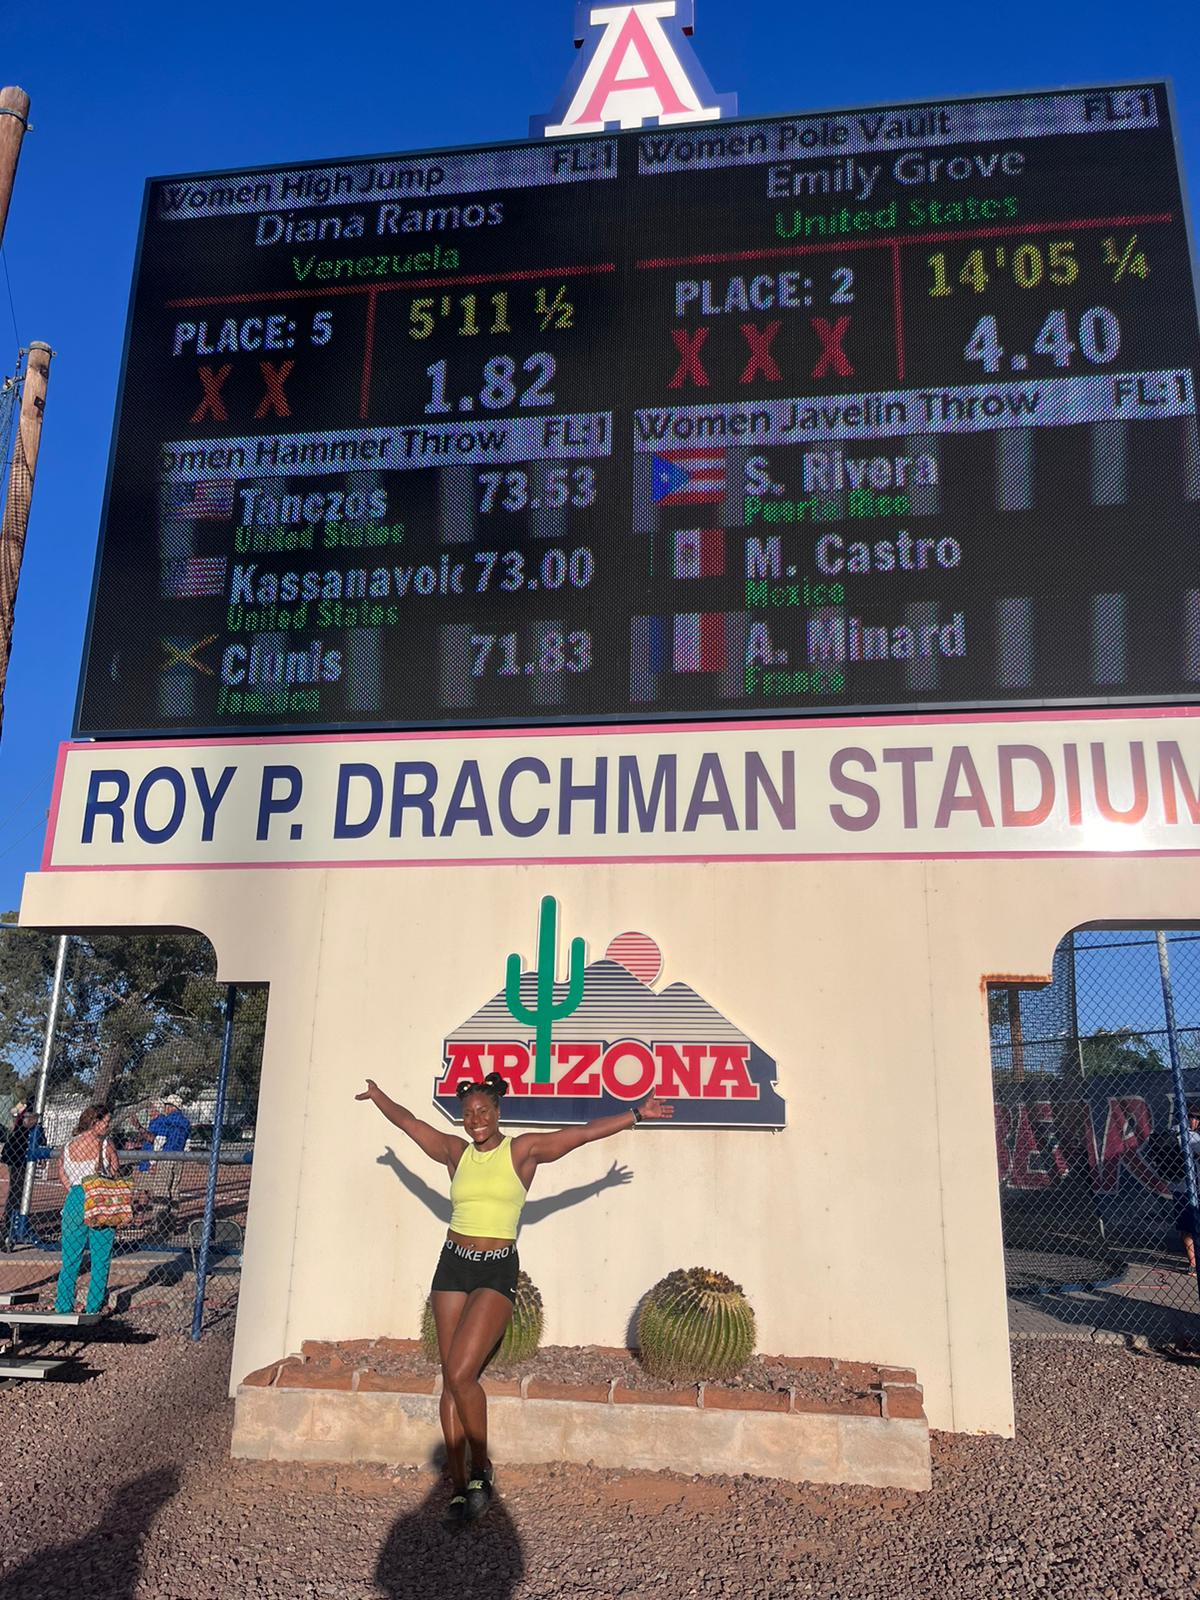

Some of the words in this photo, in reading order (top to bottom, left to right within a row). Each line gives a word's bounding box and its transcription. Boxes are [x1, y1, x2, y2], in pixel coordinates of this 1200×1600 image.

[640, 129, 767, 164] Women
[778, 121, 849, 150] Pole
[858, 110, 951, 141] Vault
[164, 174, 271, 211] Women
[281, 166, 353, 202] High
[363, 164, 445, 196] Jump
[767, 156, 882, 200] Emily
[894, 149, 1026, 186] Grove
[255, 211, 364, 247] Diana
[377, 201, 504, 236] Ramos
[775, 206, 897, 239] United
[908, 195, 1018, 228] States
[292, 244, 460, 281] Venezuela
[928, 241, 1080, 297] 14'05
[408, 292, 510, 340] 5'11
[675, 271, 814, 317] PLACE:
[829, 267, 855, 304] 2
[173, 315, 296, 356] PLACE:
[310, 311, 333, 346] 5
[964, 306, 1122, 373] 4.40
[424, 353, 556, 415] 1.82
[638, 408, 771, 440] Women
[784, 394, 906, 430] Javelin
[917, 387, 1040, 420] Throw
[163, 447, 246, 475] omen
[256, 434, 391, 467] Hammer
[400, 427, 507, 457] Throw
[744, 457, 786, 496] S.
[803, 451, 939, 491] Rivera
[239, 487, 388, 526] Tanczos
[477, 466, 598, 514] 73.53
[235, 525, 314, 554] United
[324, 521, 405, 549] States
[744, 536, 797, 579] M.
[815, 530, 963, 576] Castro
[475, 546, 595, 594] 73.00
[745, 578, 846, 609] Mexico
[226, 602, 308, 633] United
[318, 599, 399, 629] States
[744, 620, 788, 666] A.
[805, 611, 967, 664] Minard
[220, 641, 342, 688] Clunis
[470, 630, 593, 679] 71.83
[81, 765, 238, 845] ROY
[256, 764, 303, 841] P.
[333, 751, 797, 840] DRACHMAN
[828, 740, 1200, 833] STADIUM
[436, 1040, 760, 1101] ARIZONA
[454, 1244, 482, 1262] NIKE
[484, 1247, 509, 1261] PRO
